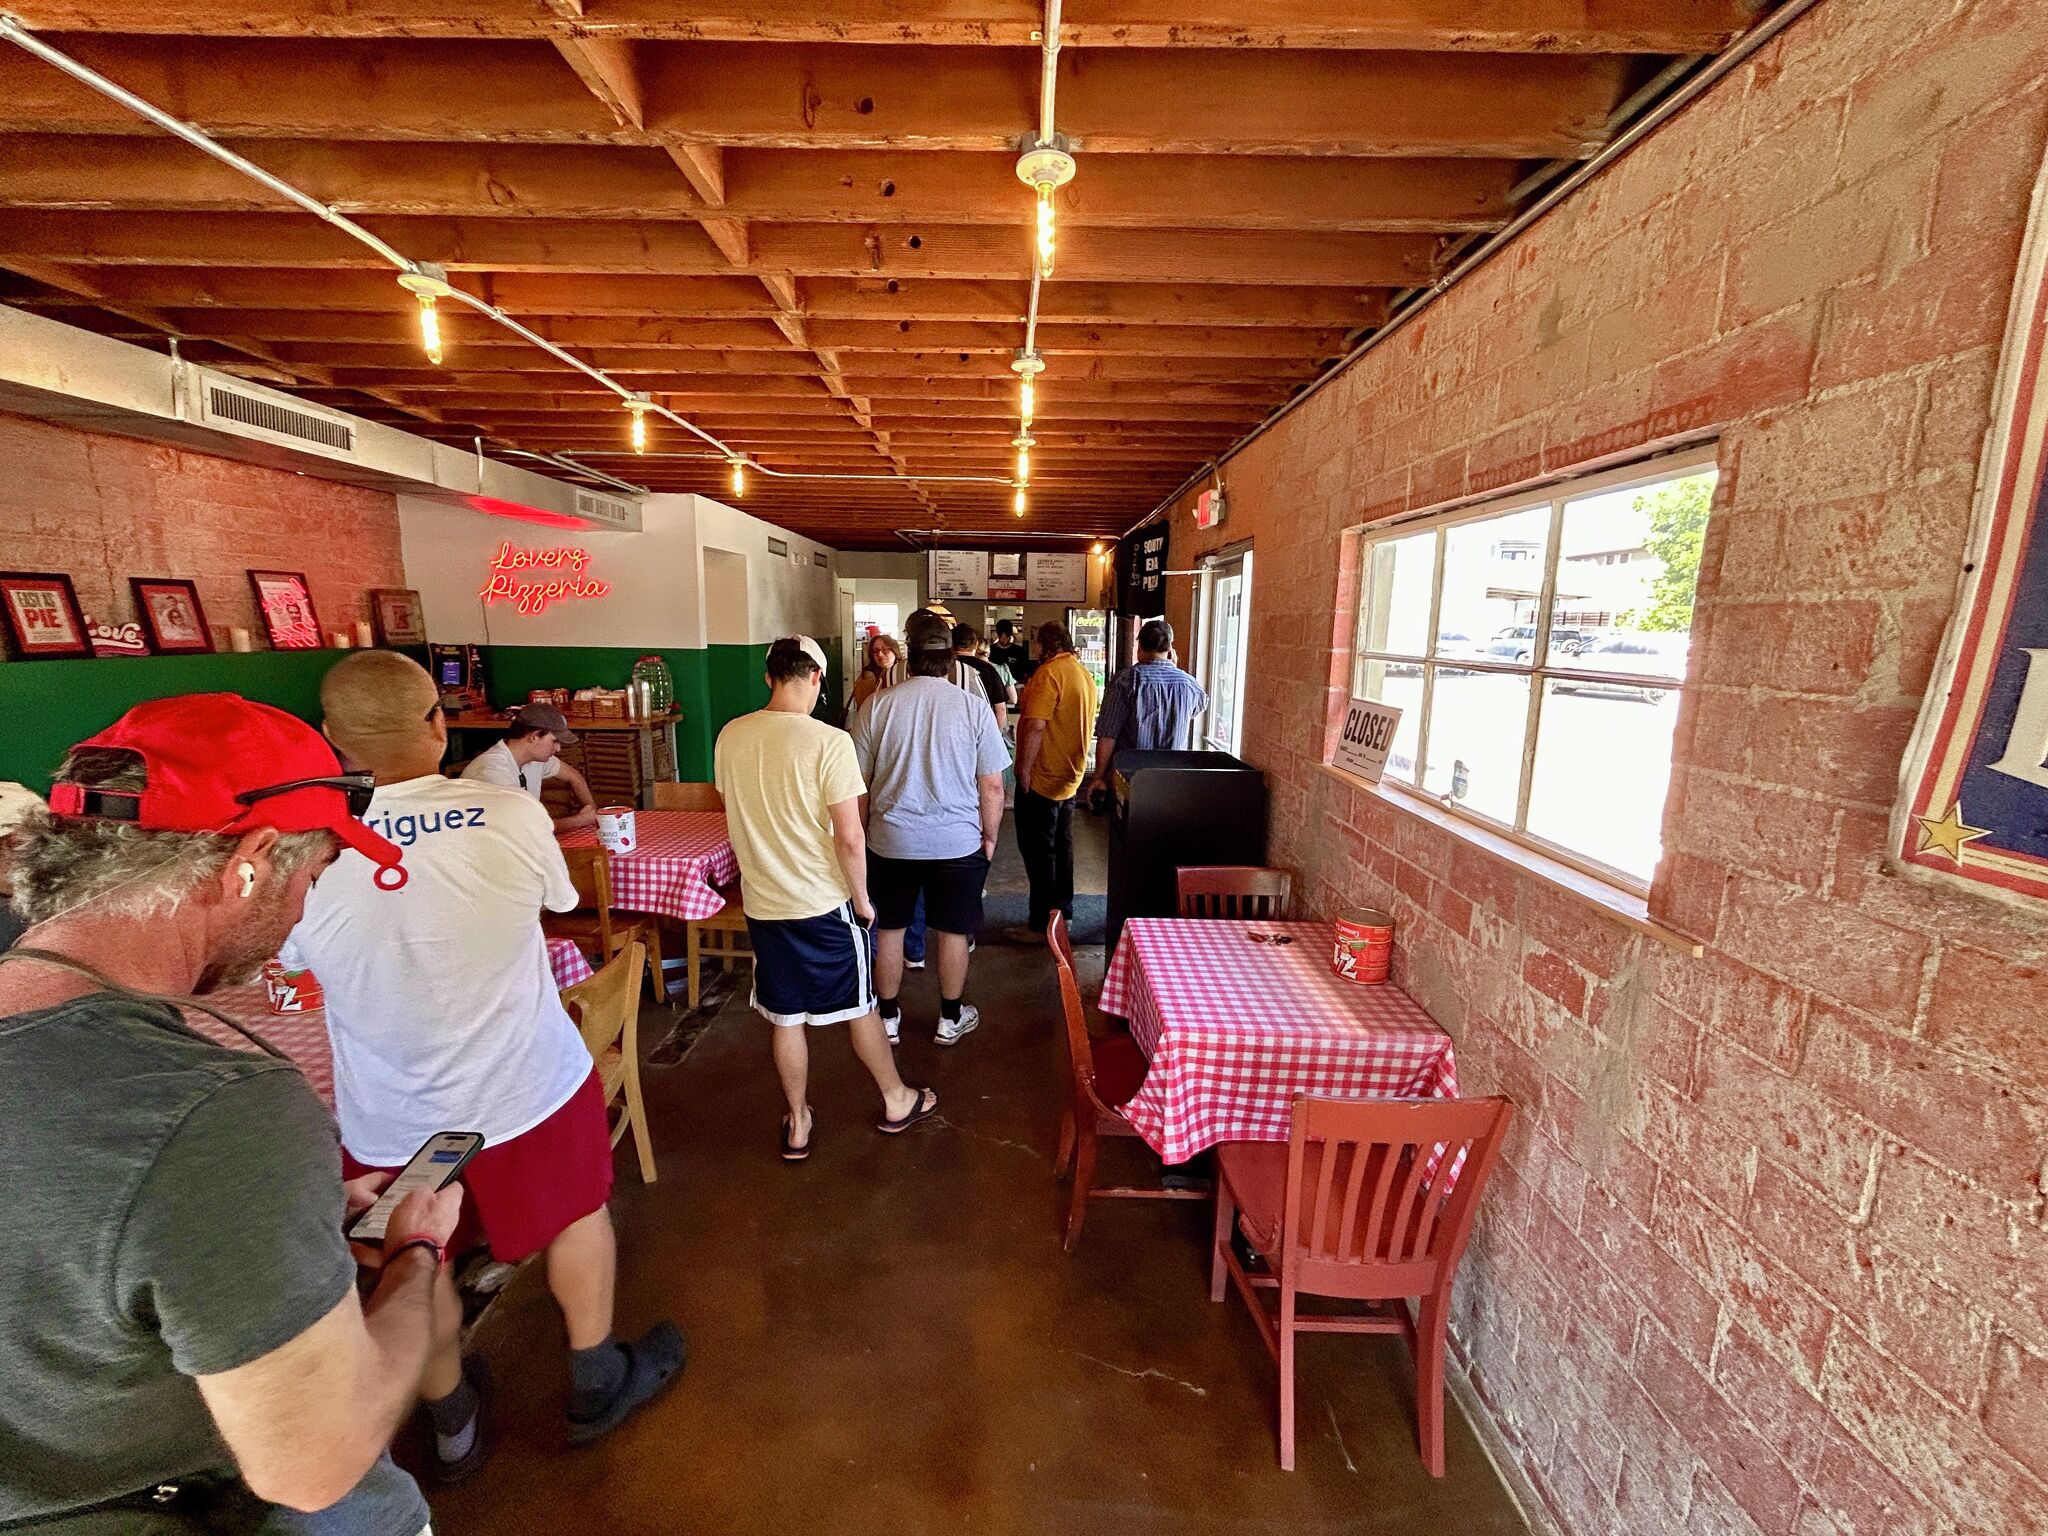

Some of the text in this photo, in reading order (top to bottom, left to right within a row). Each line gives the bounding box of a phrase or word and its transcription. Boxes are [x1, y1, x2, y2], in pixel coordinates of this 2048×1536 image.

[490, 542, 589, 571] Lovers
[479, 574, 608, 613] Pizzeria
[23, 608, 63, 629] PIE
[1343, 708, 1396, 751] CLOSED
[358, 807, 486, 846] riguez
